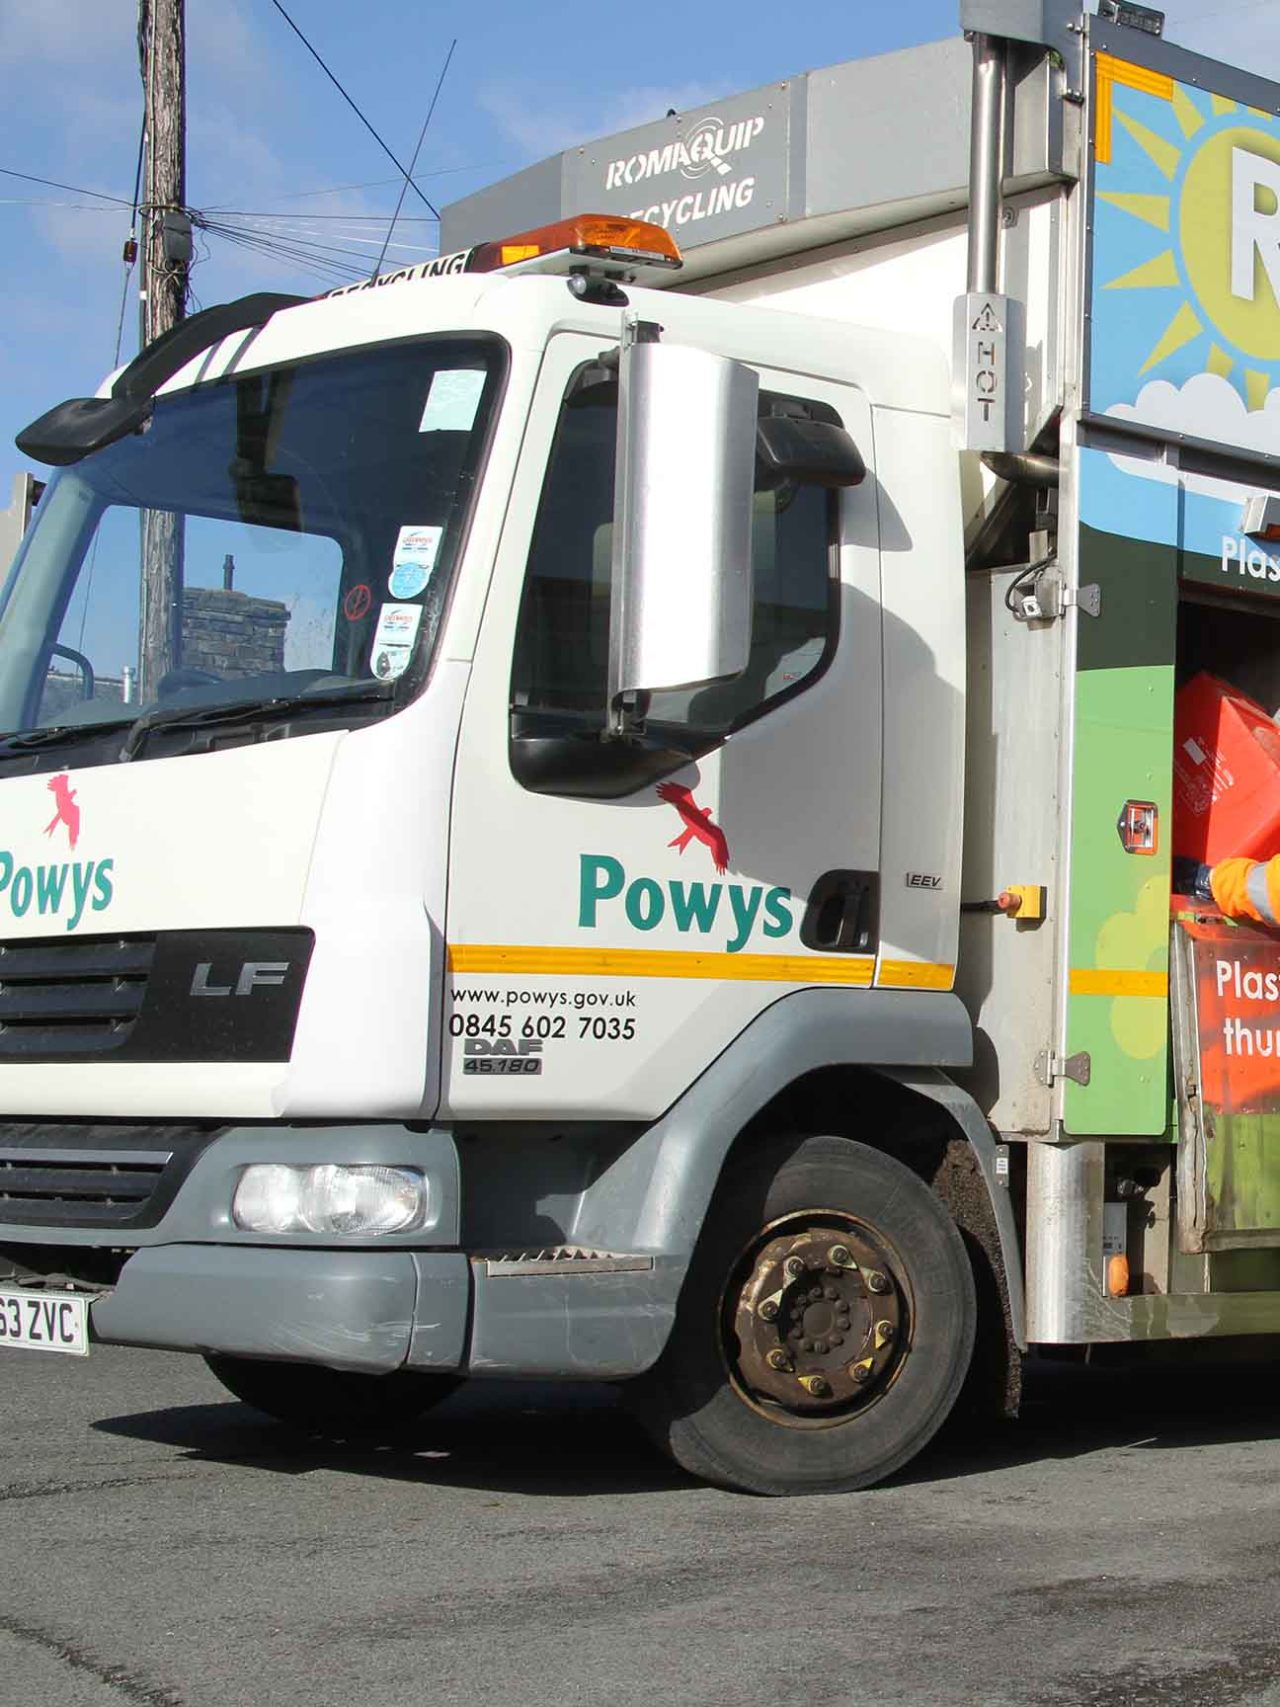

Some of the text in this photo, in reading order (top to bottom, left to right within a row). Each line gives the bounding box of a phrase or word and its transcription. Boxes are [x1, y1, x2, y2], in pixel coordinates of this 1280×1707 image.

[606, 116, 765, 191] ROMAQUIP
[622, 177, 756, 229] CYCLING
[910, 874, 942, 888] EEV
[578, 854, 793, 953] Powys
[189, 961, 290, 996] LF
[451, 989, 636, 1009] www.powys.gov.uk
[450, 1014, 636, 1040] 0845 602 7035
[463, 1038, 544, 1056] DAF
[464, 1059, 540, 1073] 45.180
[27, 1300, 74, 1343] ZVC
